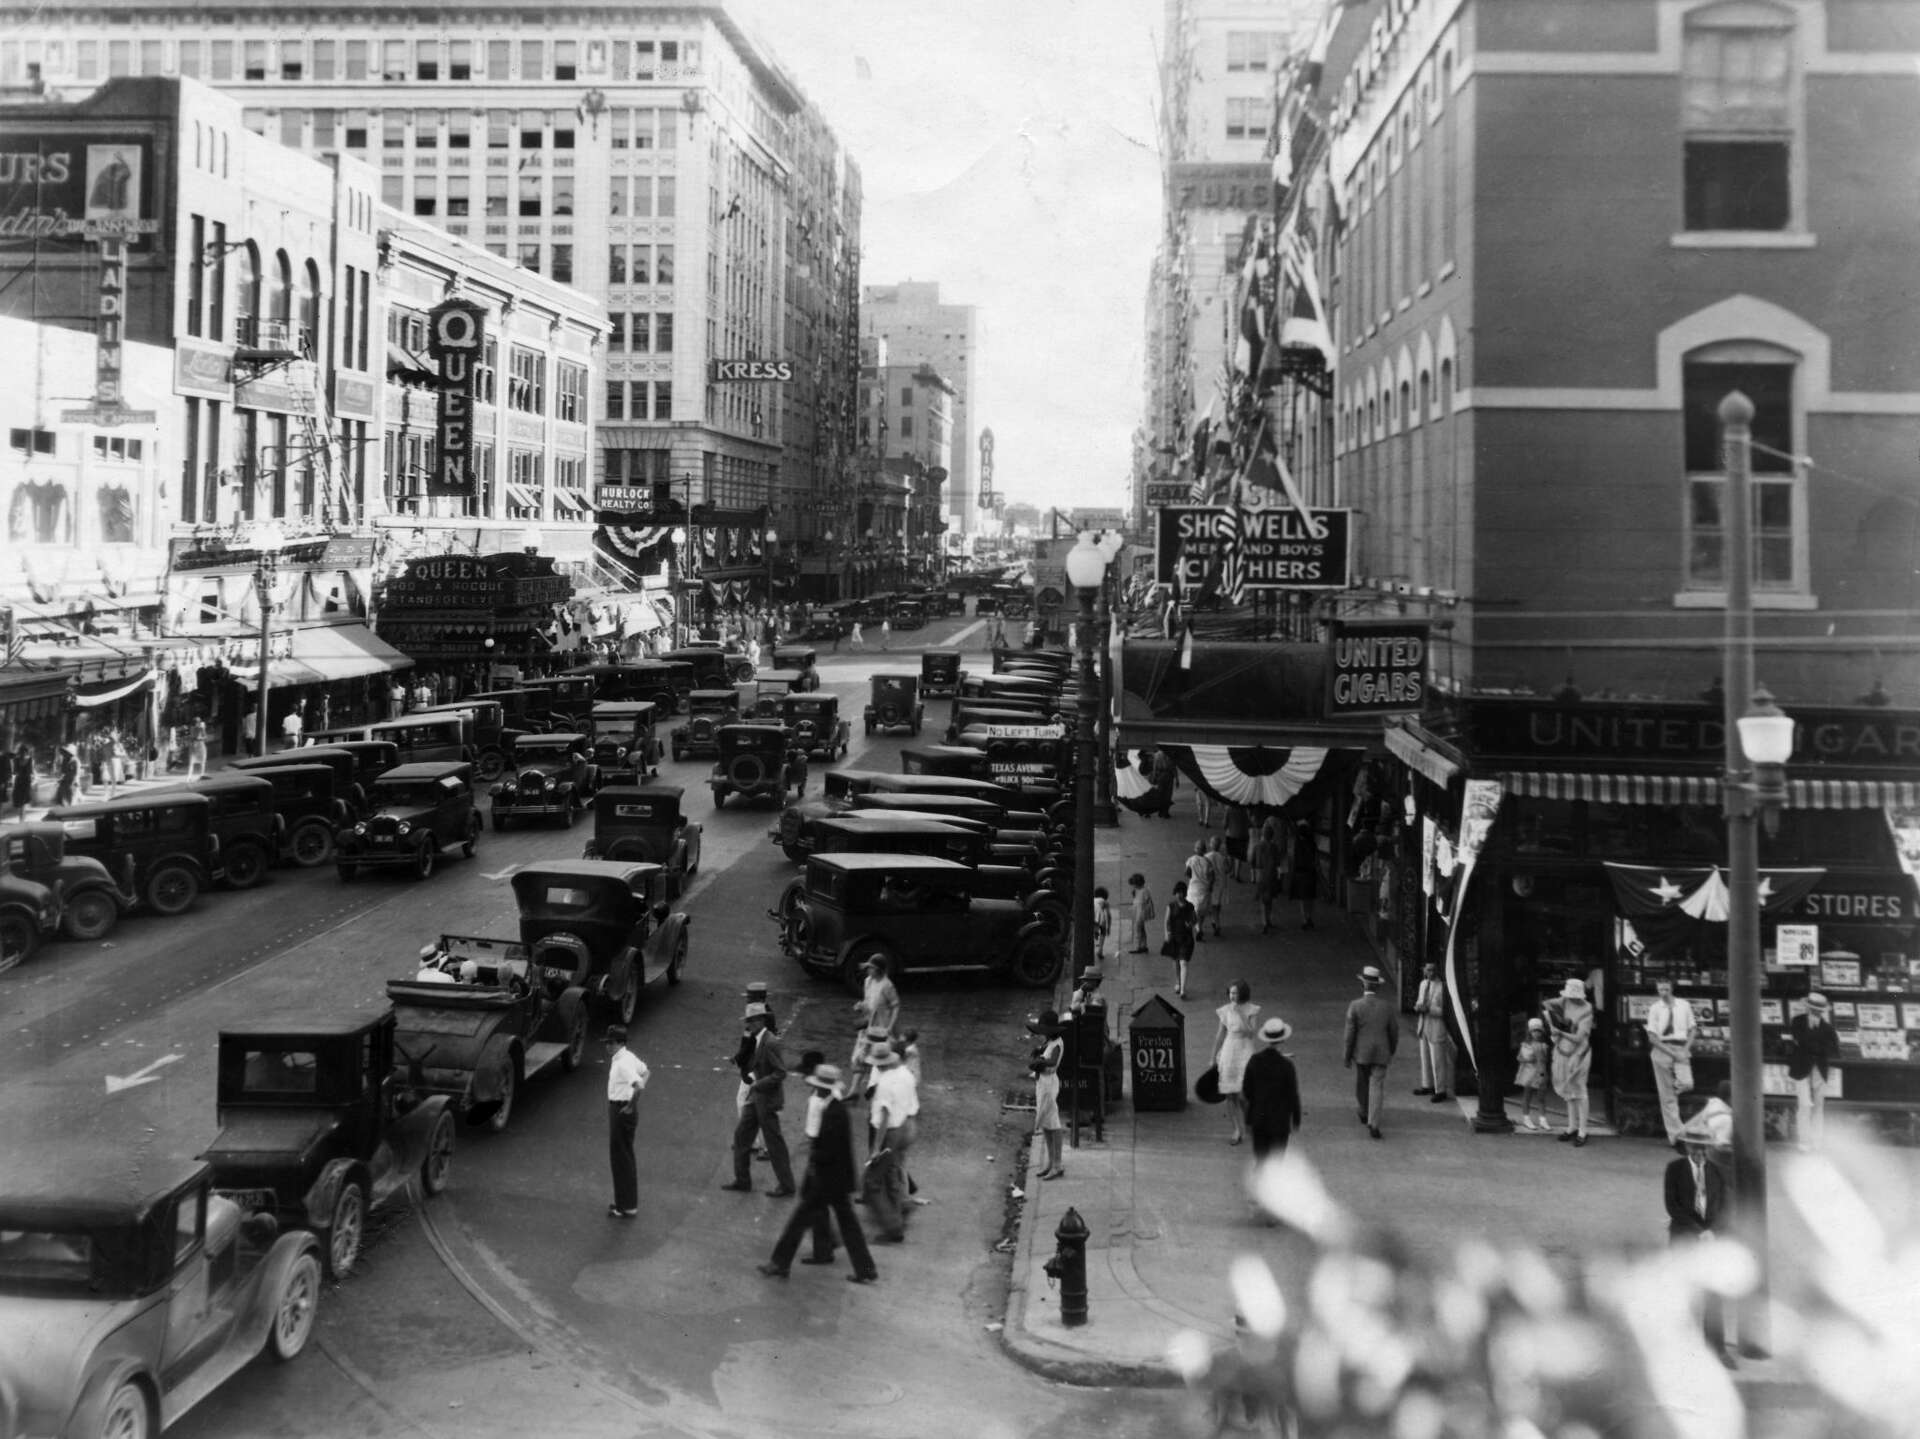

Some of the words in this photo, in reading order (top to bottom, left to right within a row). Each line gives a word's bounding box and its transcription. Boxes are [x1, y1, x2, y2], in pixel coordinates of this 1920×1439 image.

[717, 362, 792, 381] KRESS
[437, 309, 478, 485] QUEEN
[982, 438, 991, 508] KIRBY
[601, 487, 650, 499] HURLOCK
[601, 499, 636, 509] REALTY
[1243, 544, 1273, 555] AND
[1279, 544, 1324, 555] BOYS
[416, 561, 488, 580] QUEEN
[1335, 637, 1424, 669] UNITED
[1334, 672, 1422, 705] CIGARS
[1529, 712, 1725, 750] UNITED
[1793, 725, 1920, 756] IGAR
[991, 763, 1015, 773] TEXAS
[1806, 893, 1901, 919] STORES
[1138, 1035, 1172, 1048] Preston
[1136, 1048, 1175, 1069] 0121
[1140, 1069, 1174, 1084] Taxi
